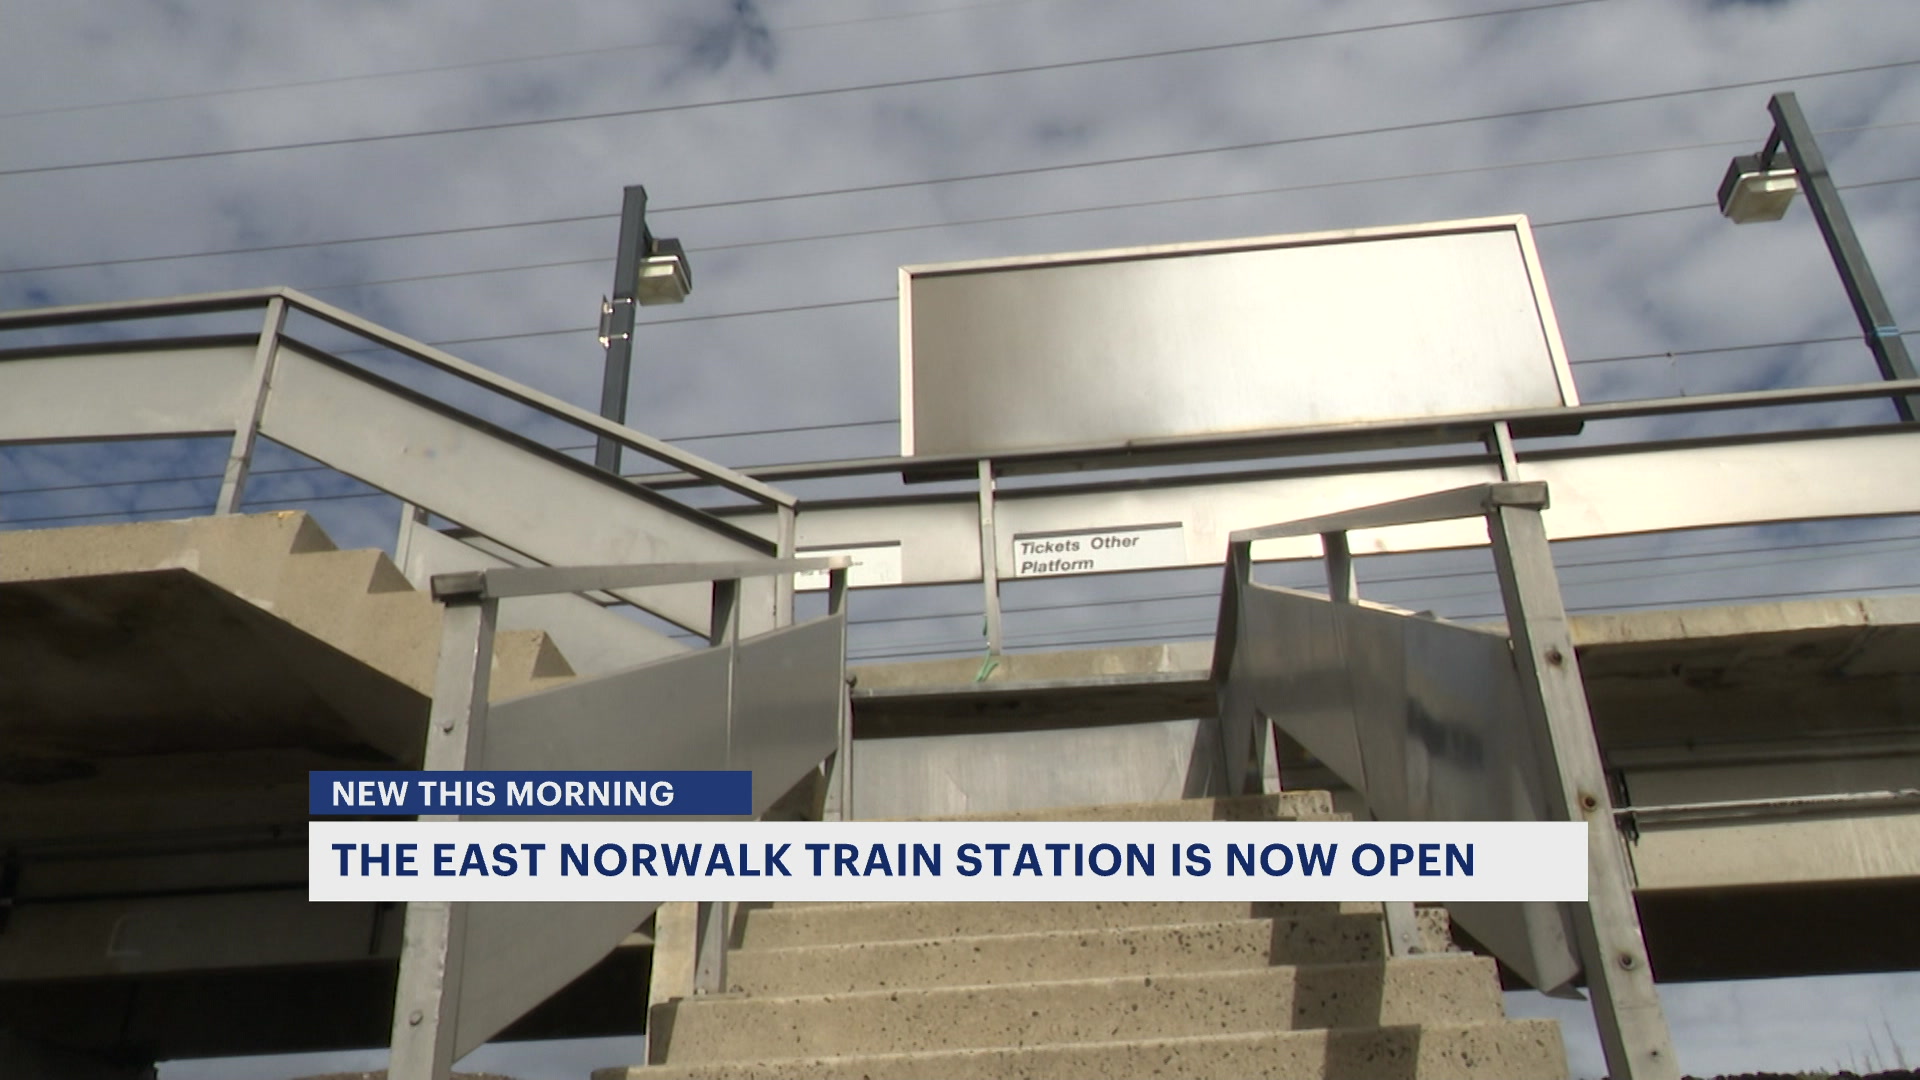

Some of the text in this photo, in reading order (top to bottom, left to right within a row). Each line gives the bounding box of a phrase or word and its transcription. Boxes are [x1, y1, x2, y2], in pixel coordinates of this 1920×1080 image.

[1021, 536, 1139, 555] Tickets Other
[1021, 559, 1094, 574] Platform
